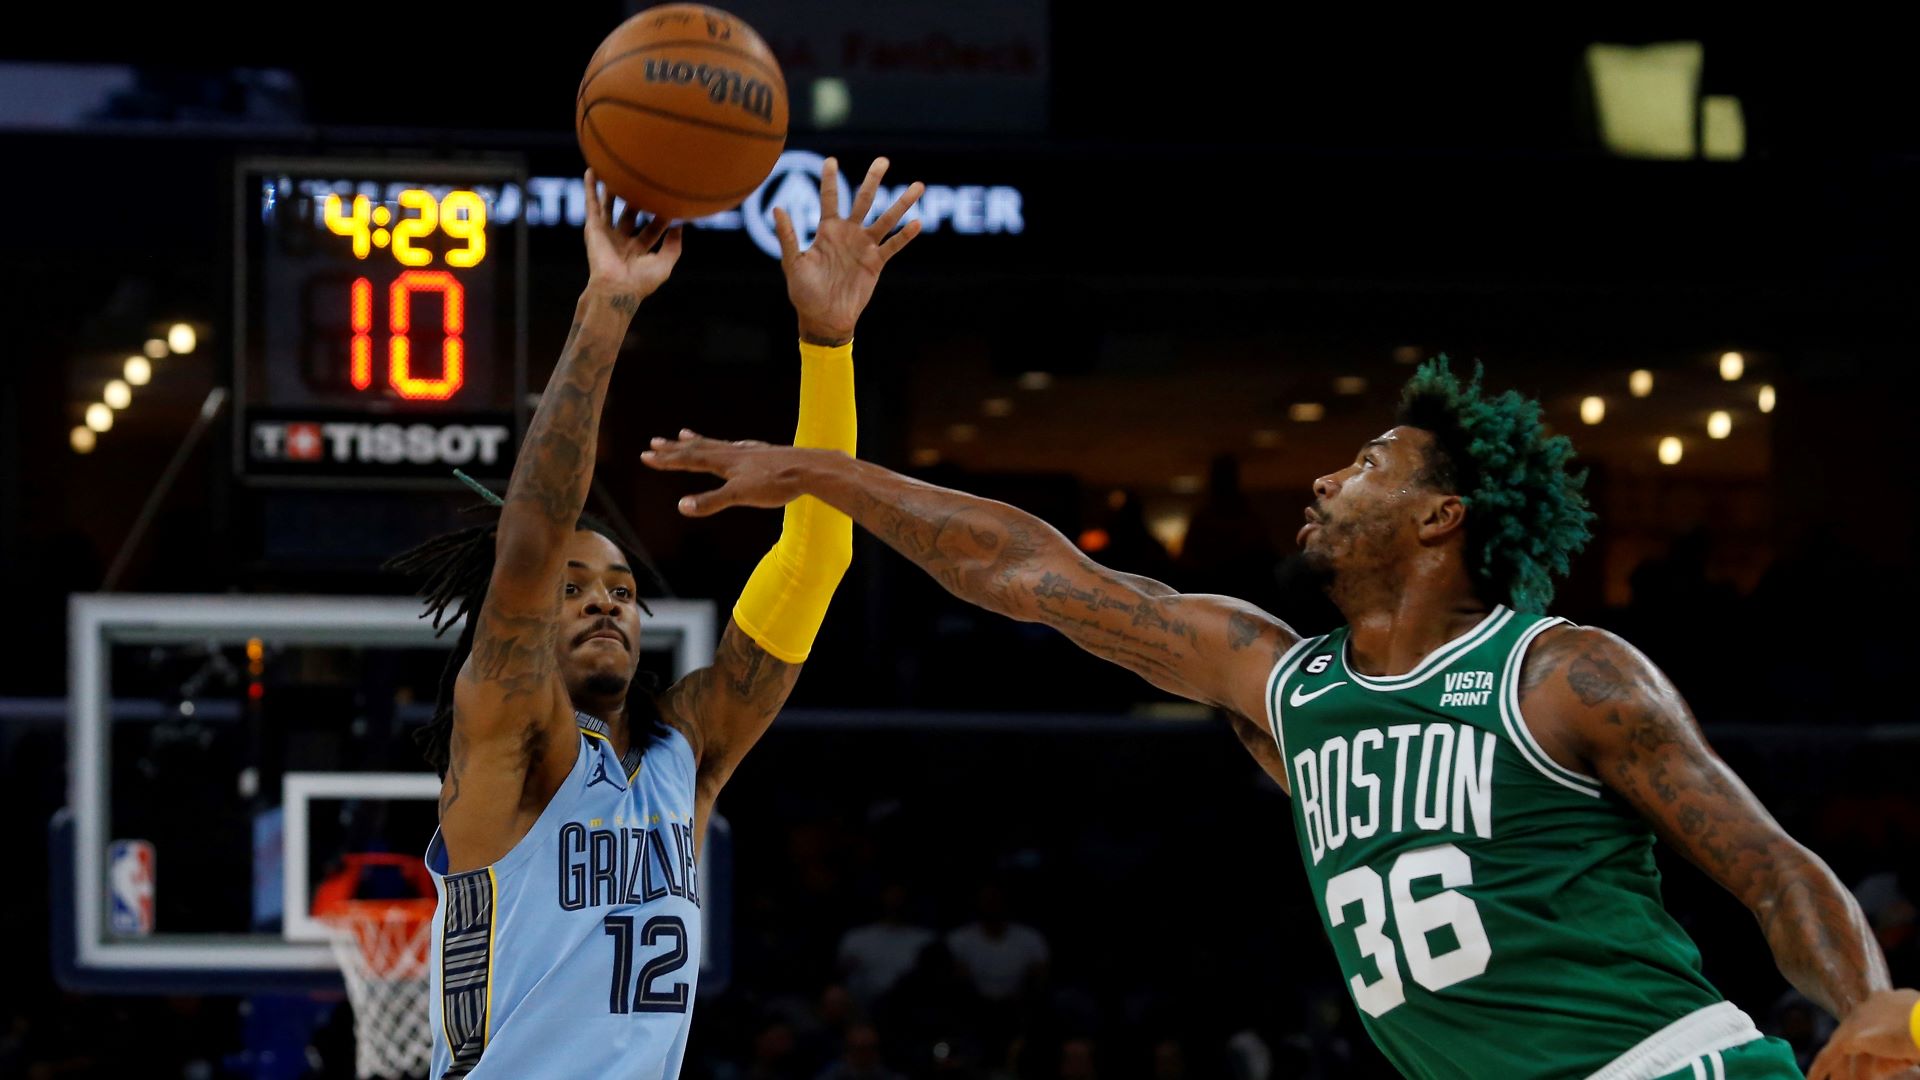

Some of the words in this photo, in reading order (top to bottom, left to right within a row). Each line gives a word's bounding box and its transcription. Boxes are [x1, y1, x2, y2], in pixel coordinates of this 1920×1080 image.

[645, 58, 774, 125] Wilson
[324, 190, 487, 267] 4:29
[351, 270, 465, 400] 10
[323, 423, 509, 464] TISSOT
[1306, 654, 1332, 674] 6
[1440, 691, 1492, 707] PRINT
[1445, 671, 1494, 692] VISTA
[1294, 723, 1497, 866] BOSTON
[604, 915, 690, 1014] 12
[1325, 843, 1492, 1019] 36
